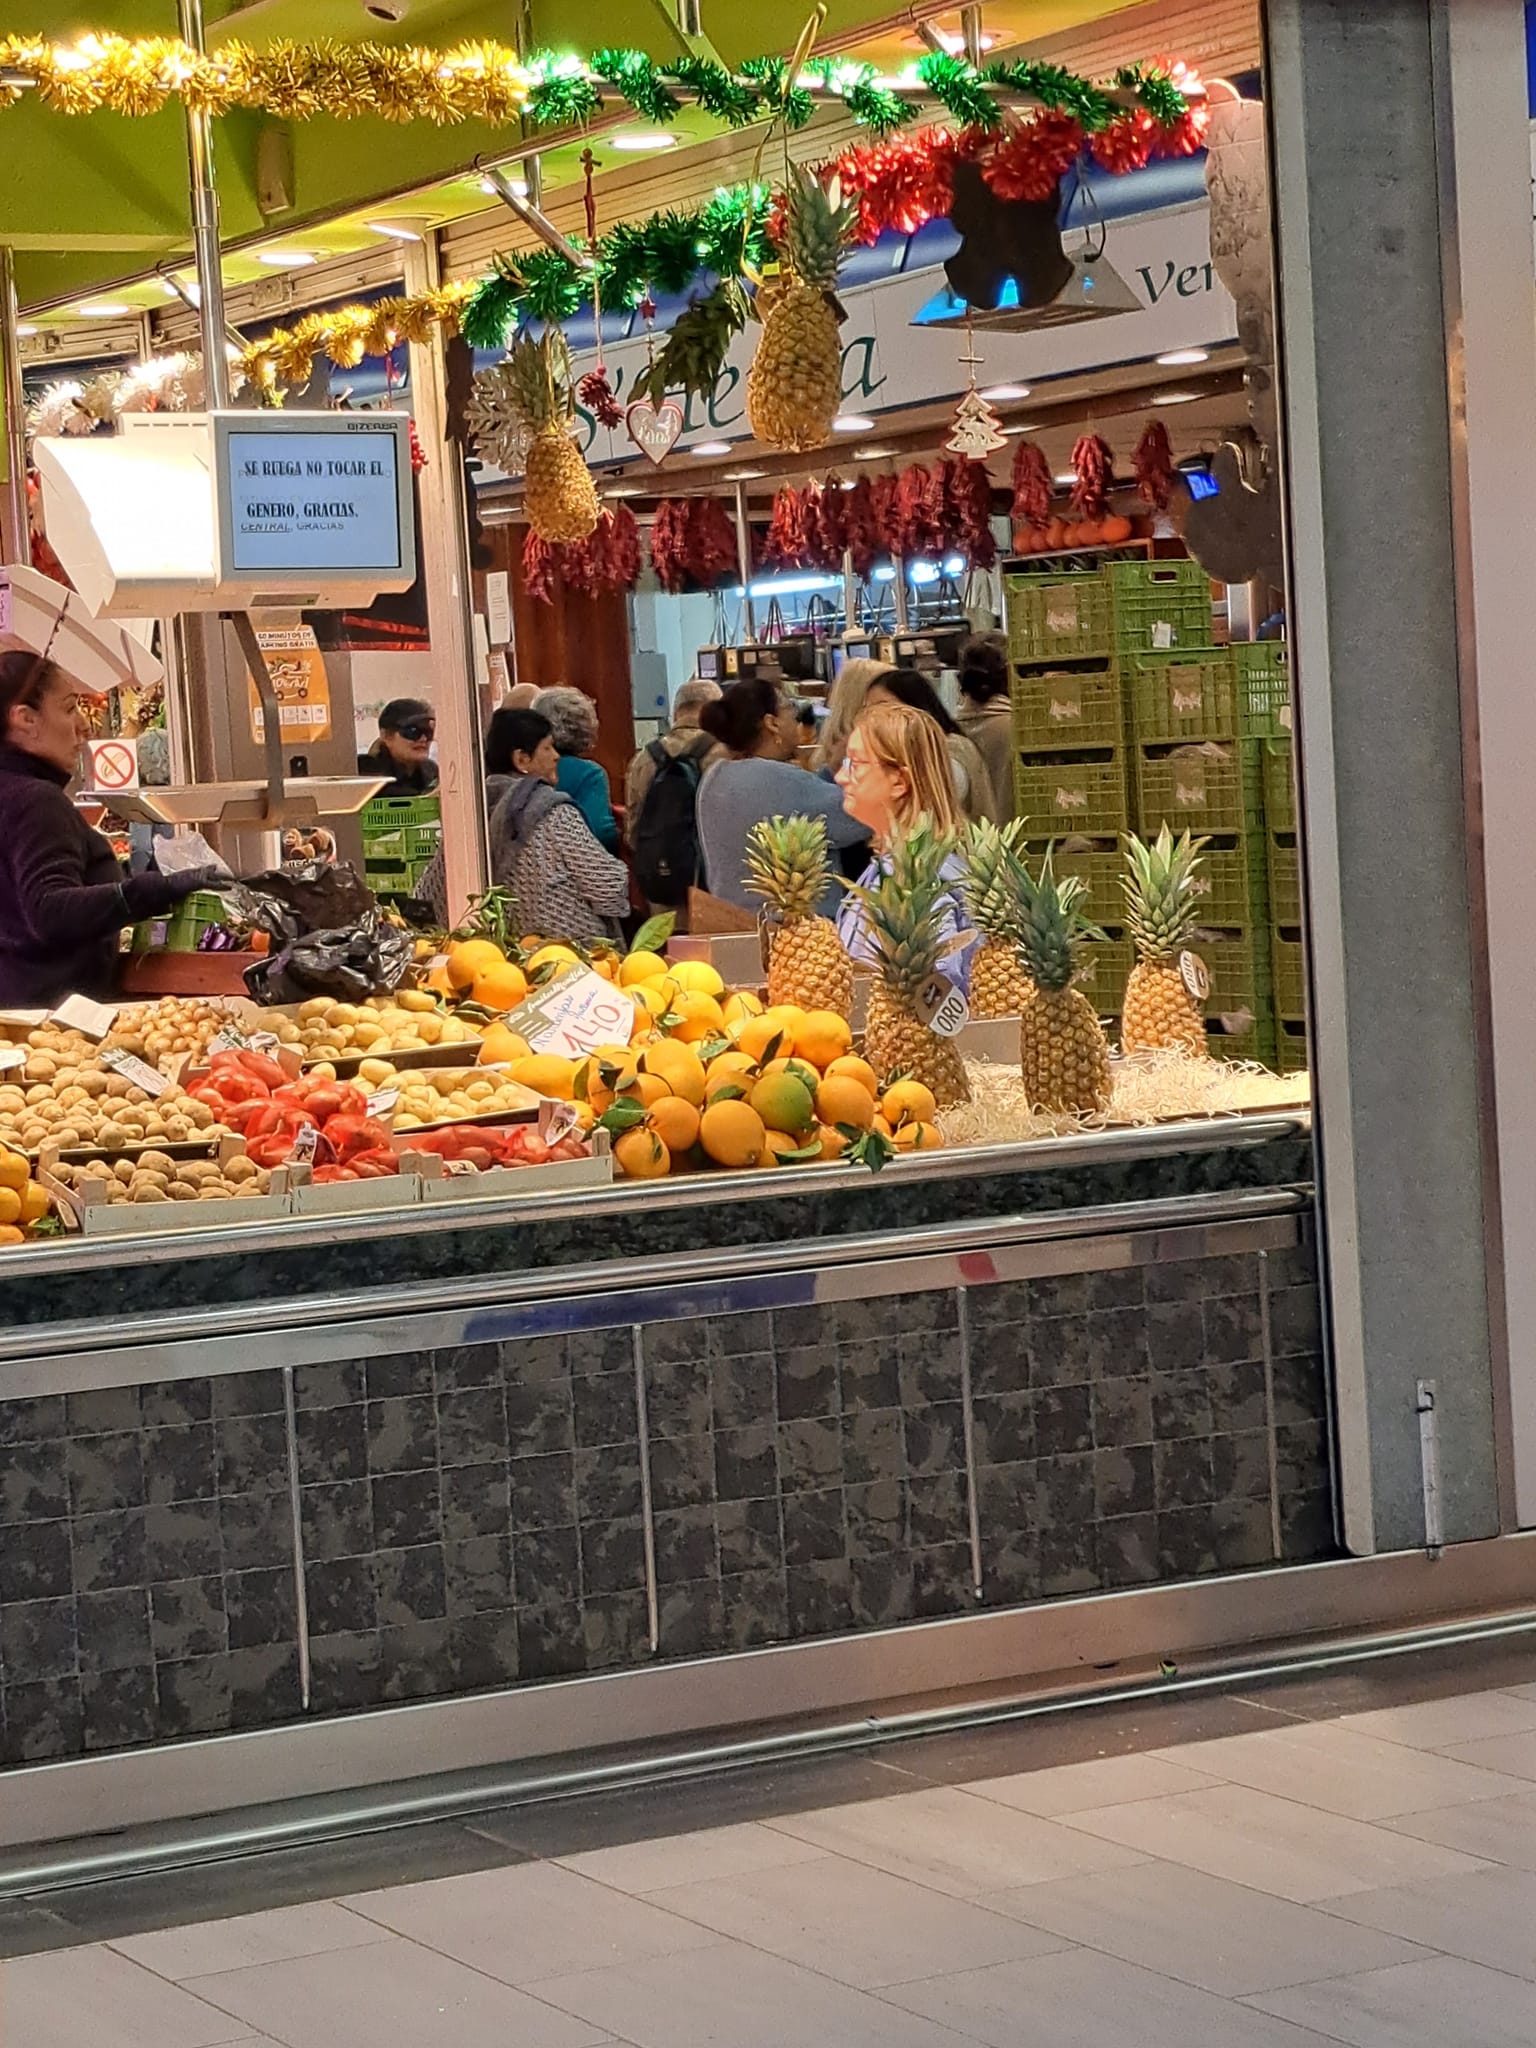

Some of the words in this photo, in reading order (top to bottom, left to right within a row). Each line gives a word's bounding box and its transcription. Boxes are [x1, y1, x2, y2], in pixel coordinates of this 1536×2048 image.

[245, 461, 258, 476] SE
[263, 461, 302, 476] RUEGA
[306, 461, 322, 476] NO
[328, 461, 366, 476] TOCAR
[370, 461, 384, 476] EL
[247, 502, 299, 519] GENERO,
[937, 996, 964, 1033] ORO
